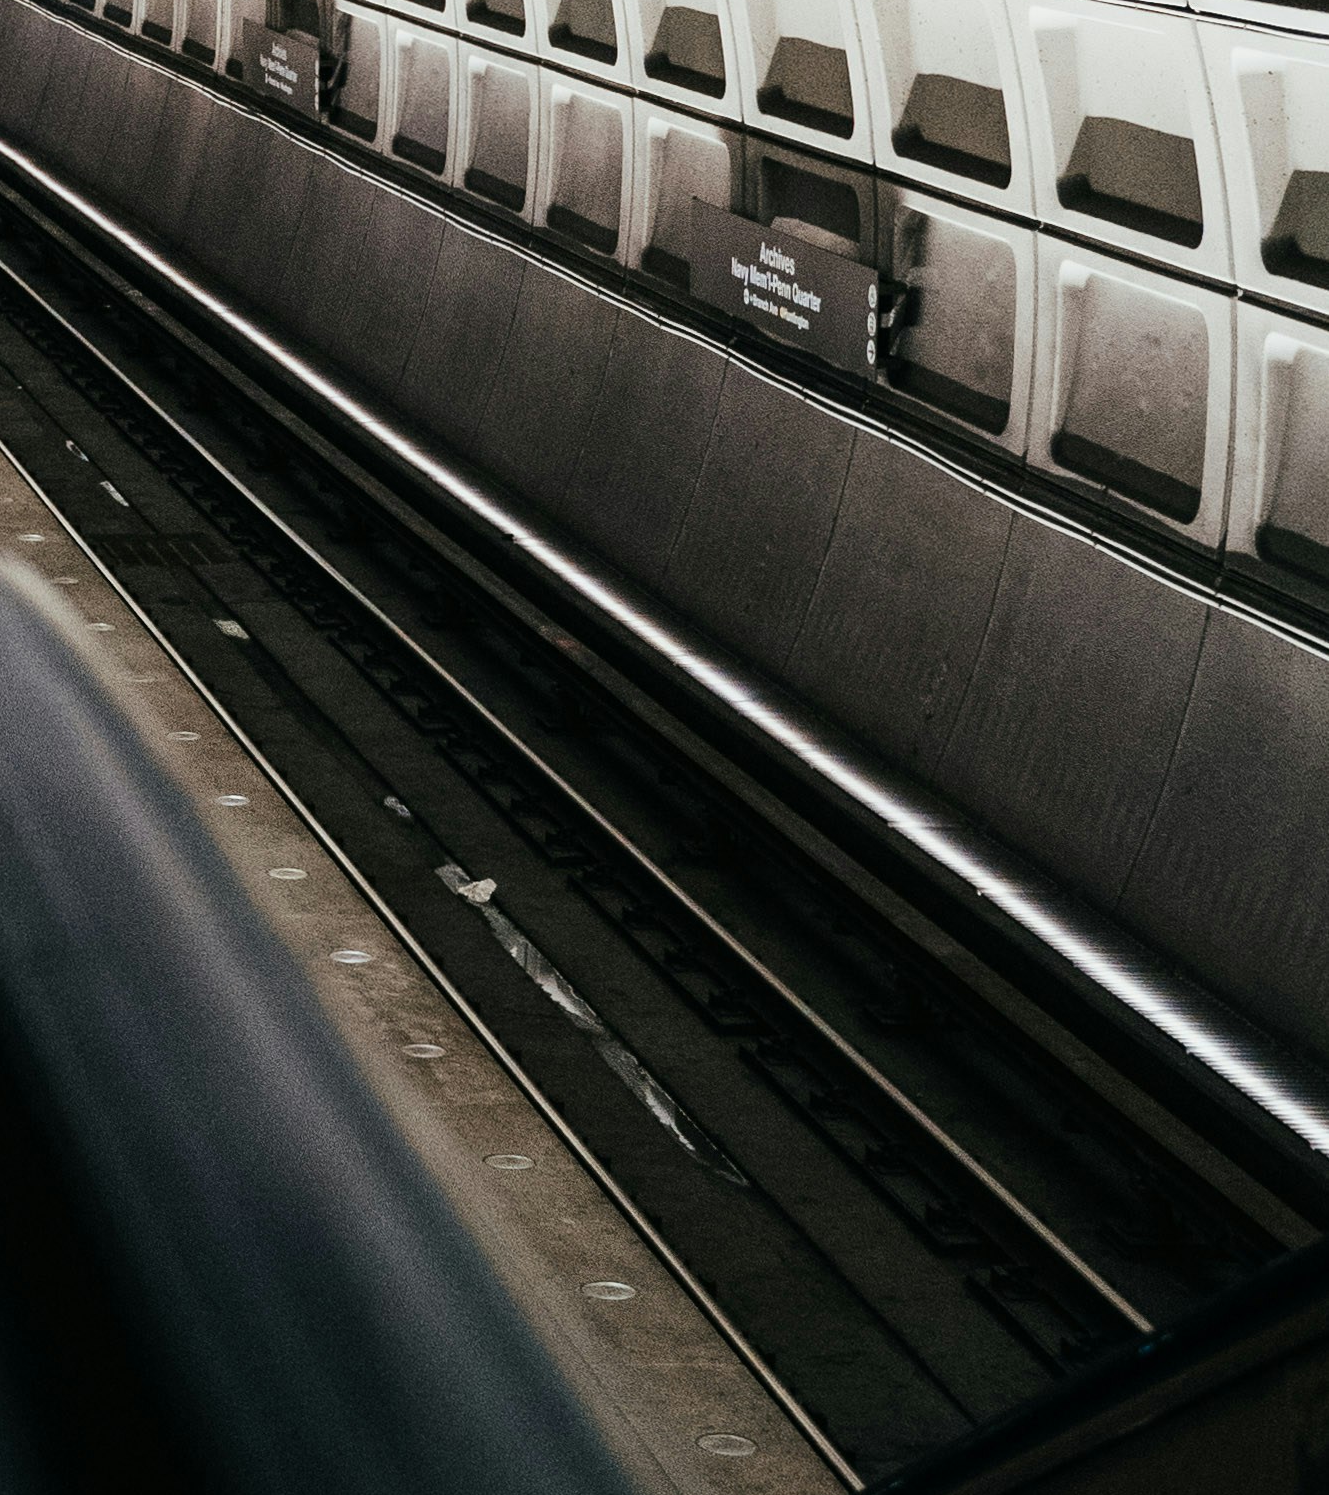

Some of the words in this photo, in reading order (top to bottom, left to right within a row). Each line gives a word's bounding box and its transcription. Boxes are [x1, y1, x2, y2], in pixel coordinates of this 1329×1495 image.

[759, 241, 795, 276] Archives
[731, 256, 749, 286] Navy
[792, 282, 821, 313] Quarter
